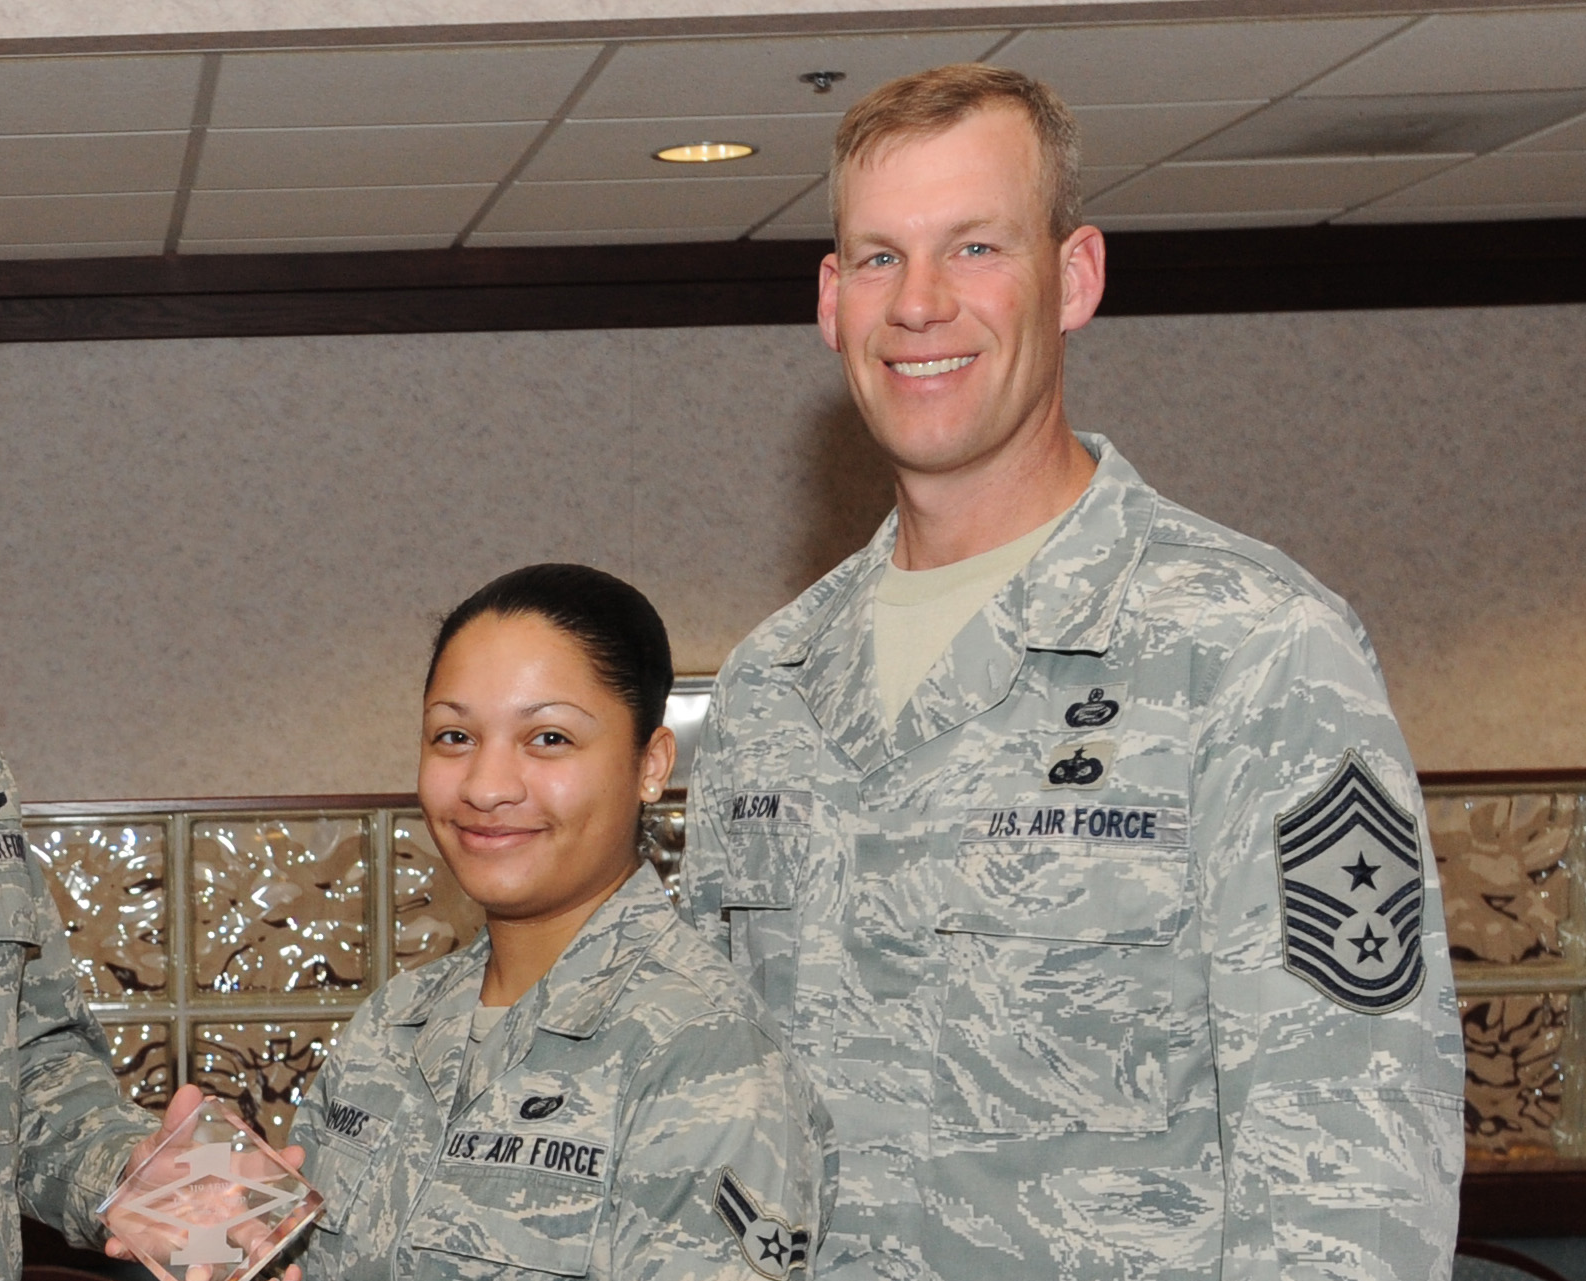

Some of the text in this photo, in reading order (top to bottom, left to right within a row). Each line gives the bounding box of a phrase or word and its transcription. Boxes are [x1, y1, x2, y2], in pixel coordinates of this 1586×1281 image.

[988, 808, 1157, 839] U.S. AIR FORCE
[447, 1132, 605, 1177] U.S. AIR FORCE
